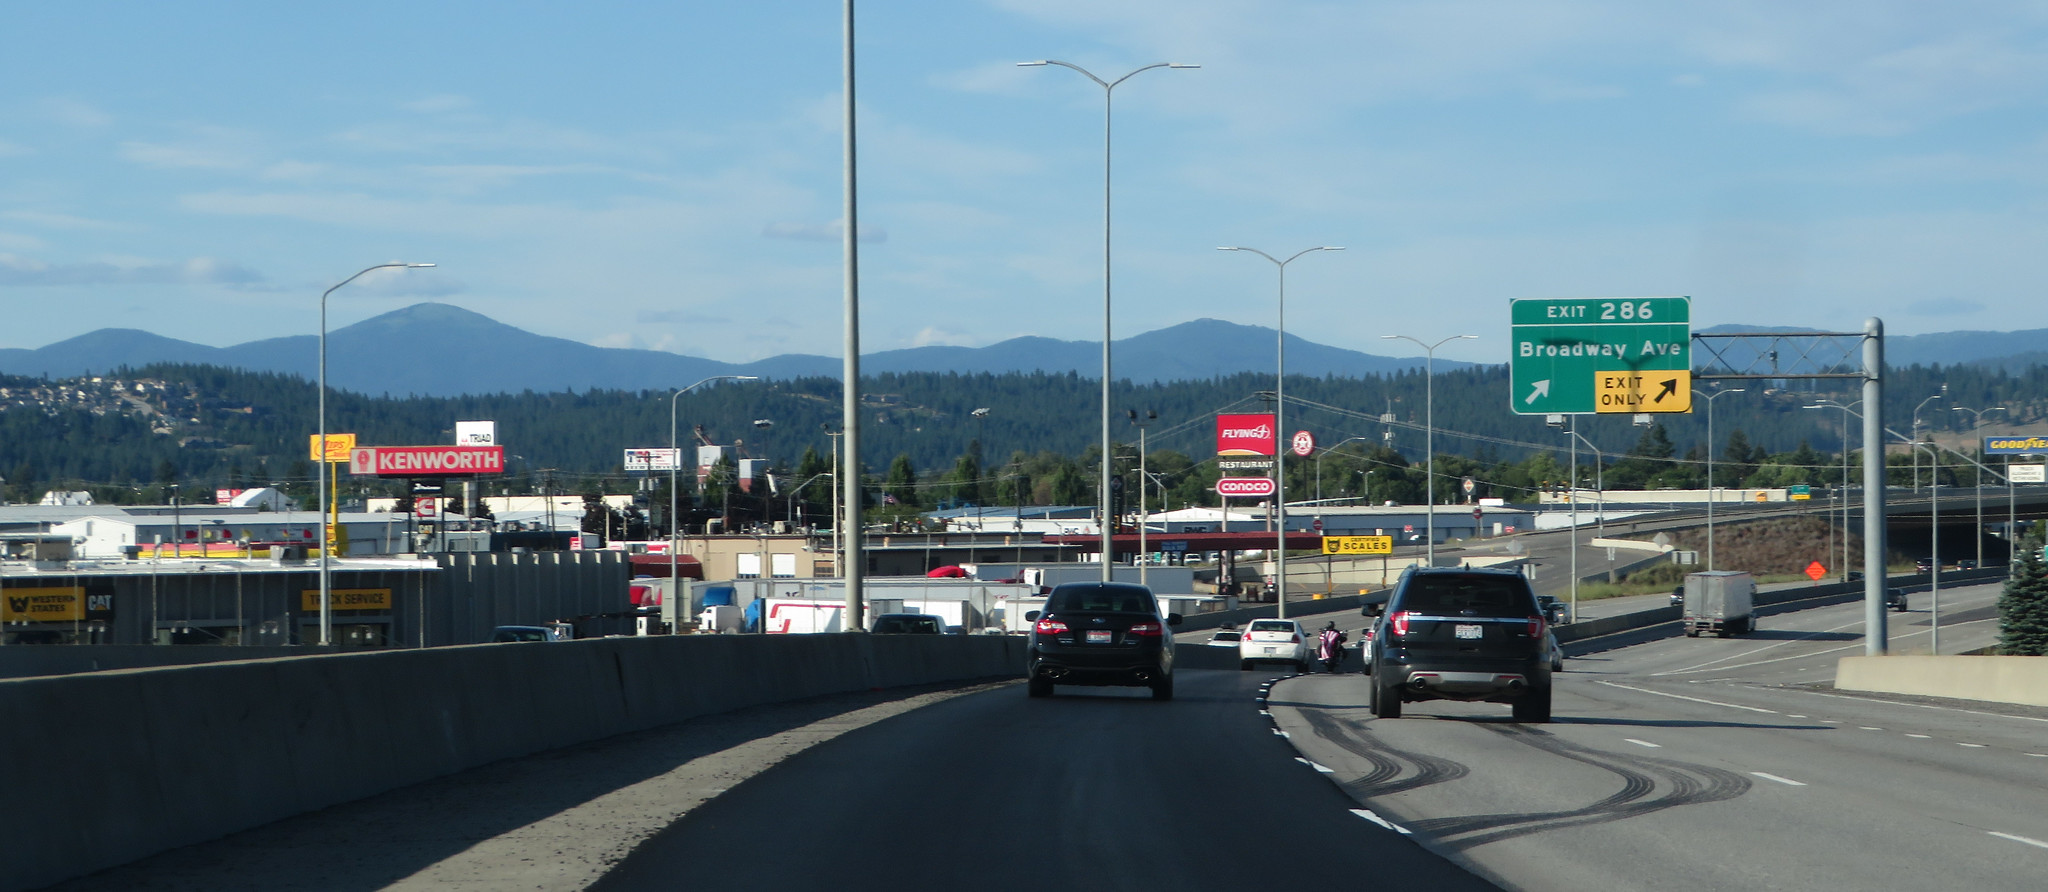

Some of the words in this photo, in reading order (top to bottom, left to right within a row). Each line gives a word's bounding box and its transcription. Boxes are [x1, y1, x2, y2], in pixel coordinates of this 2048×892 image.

[1547, 306, 1586, 318] EXIT
[1600, 302, 1653, 320] 286
[1520, 341, 1627, 359] Broadway
[1641, 340, 1681, 356] Ave
[1605, 377, 1643, 389] EXIT
[1601, 394, 1647, 406] ONLY
[469, 434, 492, 443] TRIAD
[1222, 428, 1258, 438] FLYING
[380, 451, 499, 470] KENWORTH
[1219, 461, 1274, 469] RESTAURANT
[1344, 542, 1388, 550] SCALES
[31, 595, 76, 603] WESTERN
[88, 595, 112, 610] CAT
[310, 594, 341, 605] TRCK
[344, 593, 384, 605] SERVICE
[31, 604, 65, 612] STATES
